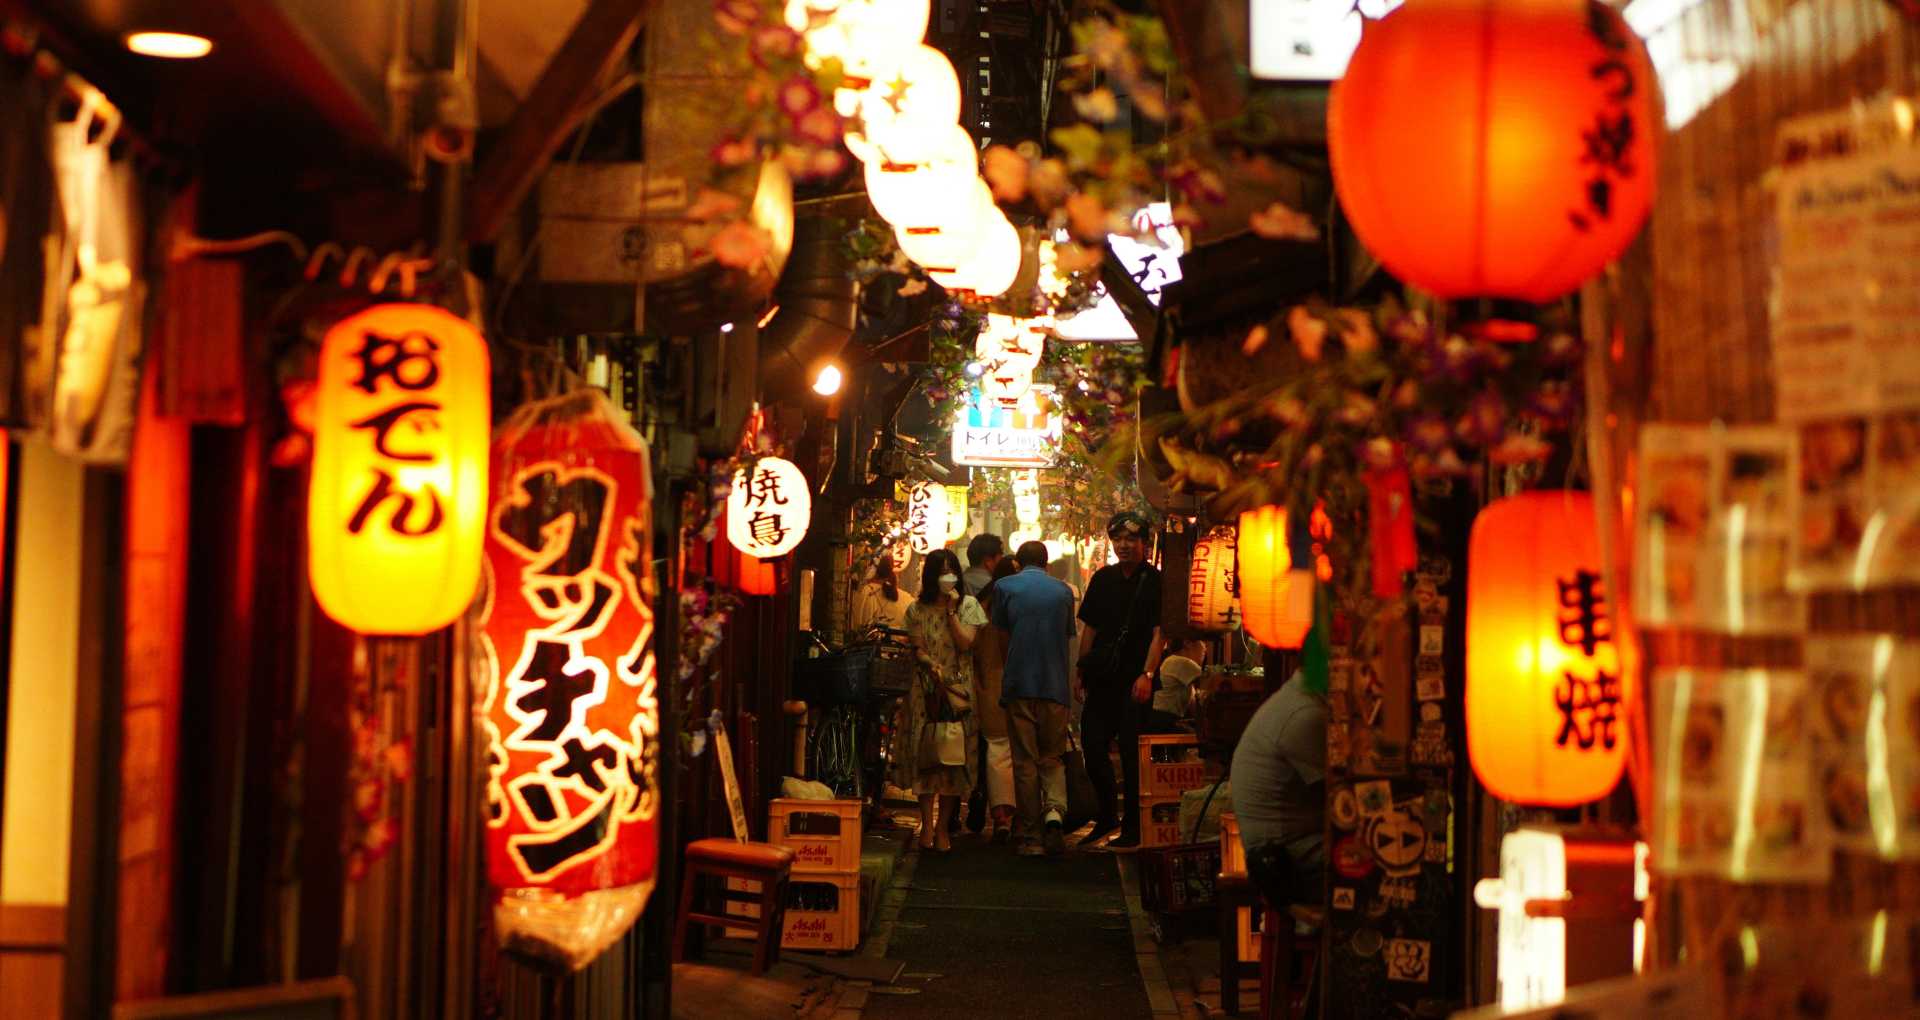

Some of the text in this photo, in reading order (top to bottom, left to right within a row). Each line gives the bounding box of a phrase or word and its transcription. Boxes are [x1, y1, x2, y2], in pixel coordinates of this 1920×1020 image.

[347, 331, 444, 537] おでん
[966, 431, 1009, 446] トイレ
[738, 467, 791, 548] 焼鳥
[1555, 569, 1621, 751] 串焼
[799, 844, 828, 857] Asahi
[792, 917, 826, 931] Asahi
